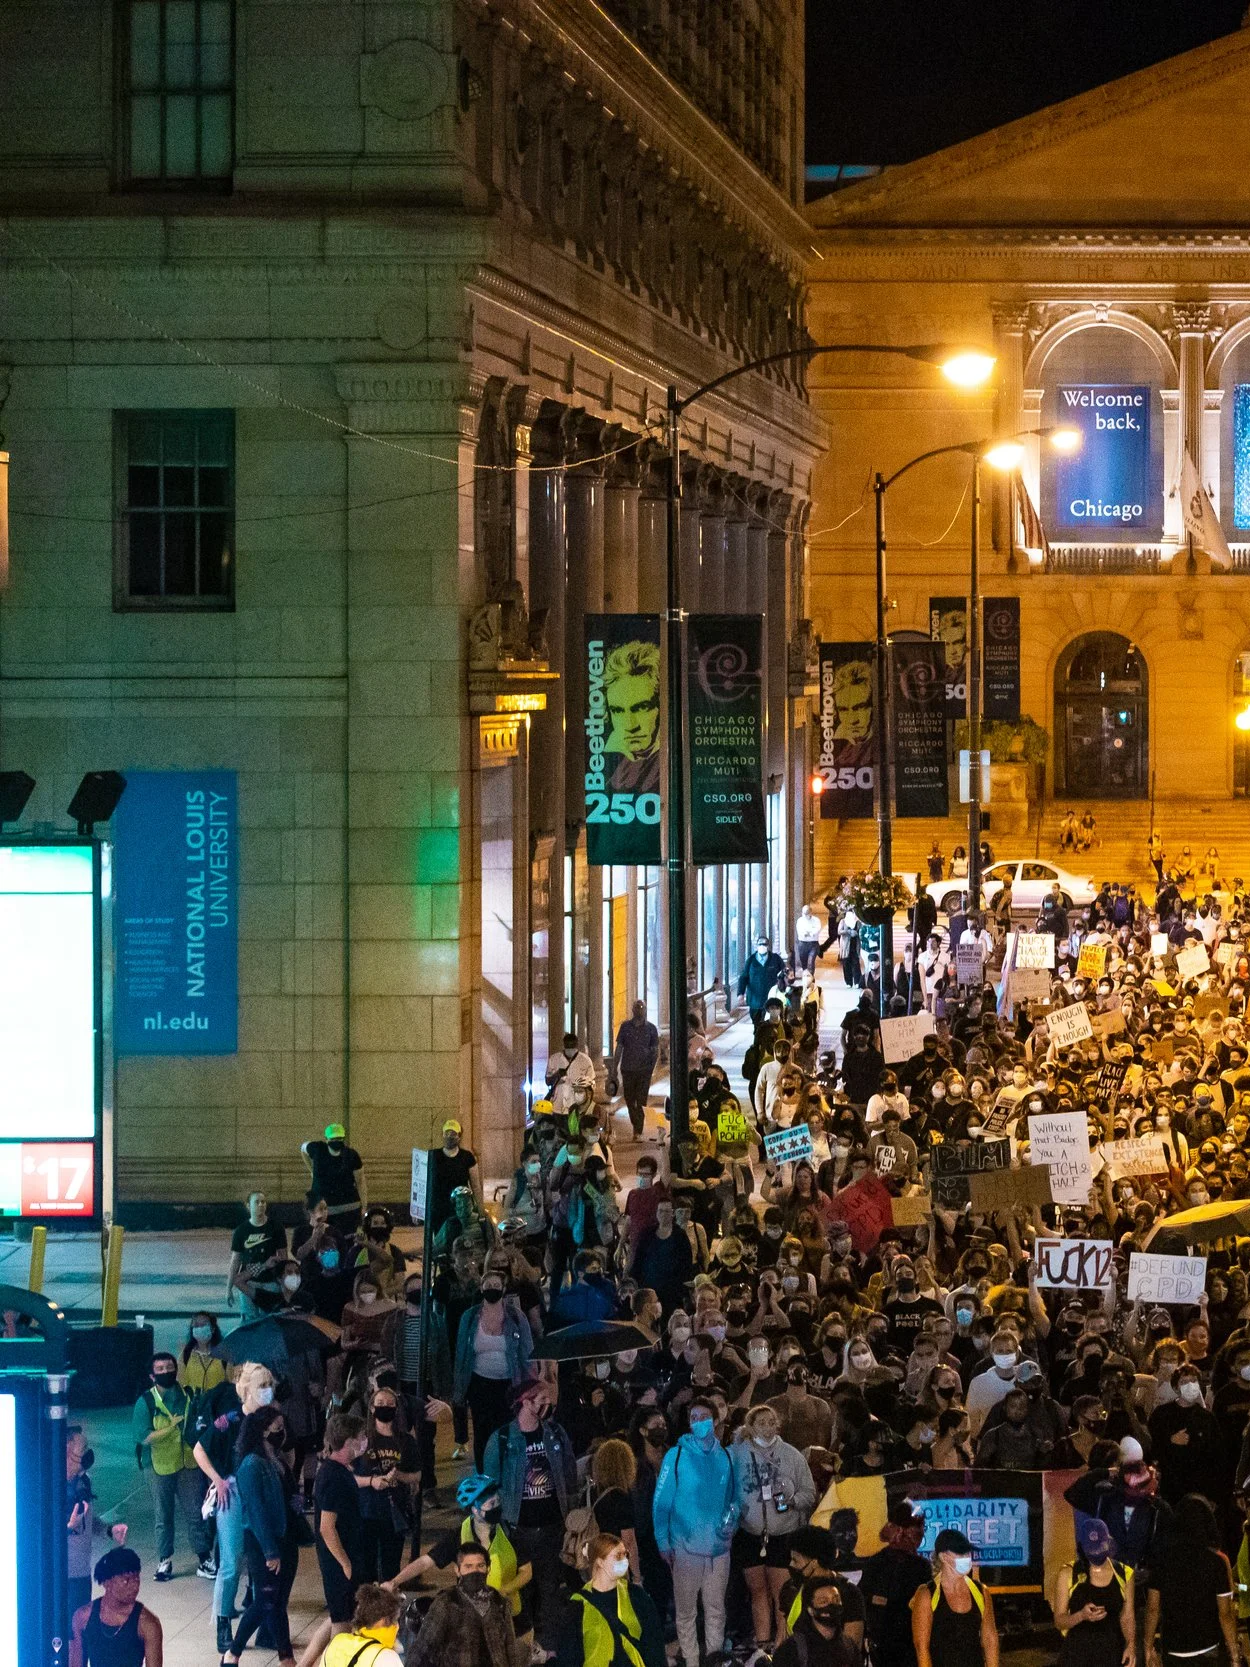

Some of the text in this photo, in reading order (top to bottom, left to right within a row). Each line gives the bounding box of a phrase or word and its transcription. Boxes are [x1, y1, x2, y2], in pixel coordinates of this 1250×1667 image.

[1075, 264, 1113, 280] THE
[1143, 264, 1184, 280] ART
[1062, 391, 1143, 408] Welcome
[1095, 413, 1141, 432] back,
[1070, 500, 1143, 521] Chicago
[945, 684, 967, 700] 50
[584, 640, 604, 791] Beethoven
[695, 715, 756, 725] CHICAGO
[819, 660, 834, 766] Beethoven
[695, 726, 756, 736] SYMPHONY
[898, 726, 943, 734] ORCHESTRA
[695, 736, 756, 746] ORCHESTRA
[695, 756, 756, 766] RICCARDO
[714, 767, 739, 776] MUTI
[820, 767, 874, 790] 250
[703, 793, 752, 803] CSO.ORG
[585, 793, 661, 825] 250
[716, 815, 743, 824] SIDLEY
[209, 791, 228, 928] UNIVERSITY
[186, 790, 205, 998] NATIONAL LOUIS
[144, 1012, 209, 1030] nl.edu
[1050, 1007, 1083, 1025] ENOUGH
[1067, 1020, 1076, 1030] IS
[1057, 1025, 1090, 1044] ENOUGH
[1034, 1122, 1072, 1134] Without
[1115, 1137, 1153, 1149] RESPECT
[1037, 1148, 1053, 1161] You
[1049, 1163, 1079, 1176] ITCH
[1052, 1177, 1080, 1189] HALF
[1037, 1241, 1097, 1287] FUCK
[1130, 1258, 1205, 1277] #DEFUND
[1137, 1277, 1193, 1299] CPD
[922, 1502, 1019, 1519] OLIDARITY
